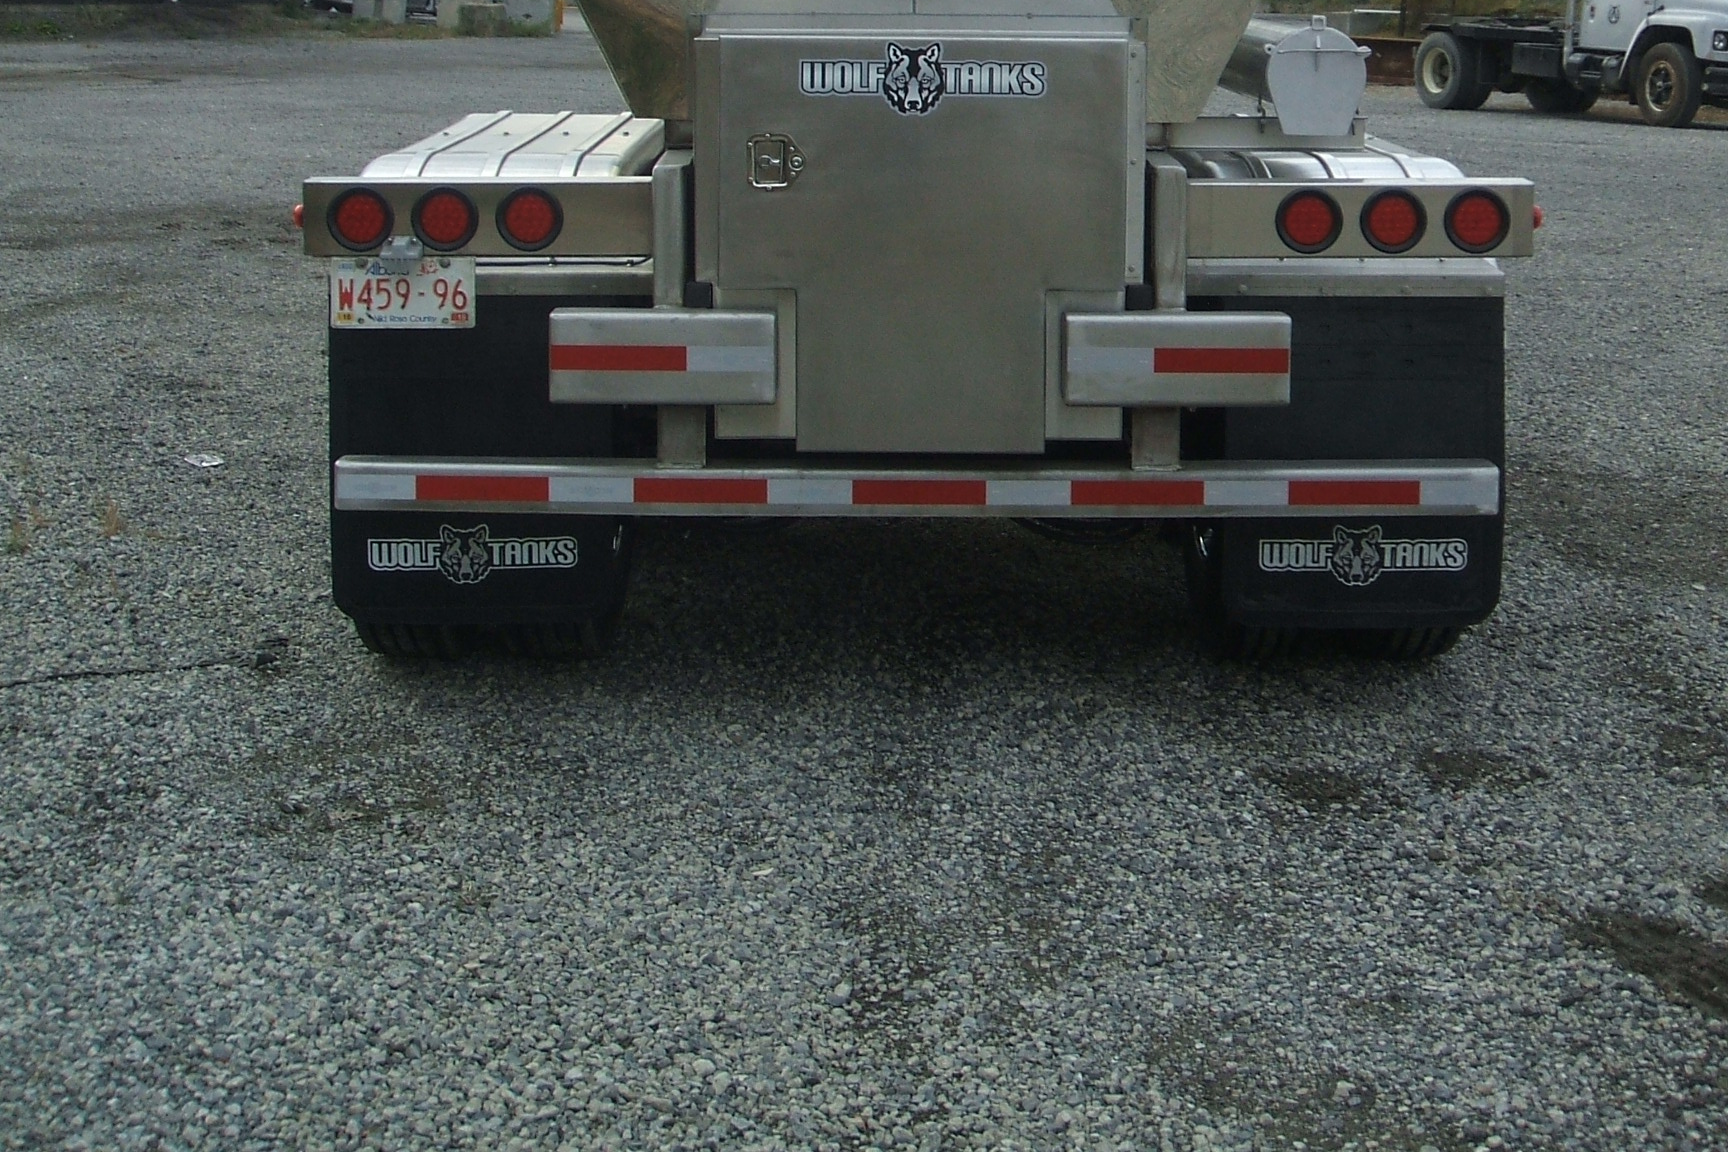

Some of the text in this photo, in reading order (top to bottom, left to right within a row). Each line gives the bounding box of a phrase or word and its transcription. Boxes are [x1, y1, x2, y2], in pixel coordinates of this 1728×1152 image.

[801, 60, 1046, 96] WOLF TANKS
[372, 540, 574, 565] WOLF TANKS
[1263, 542, 1466, 567] WOLF TANKS
